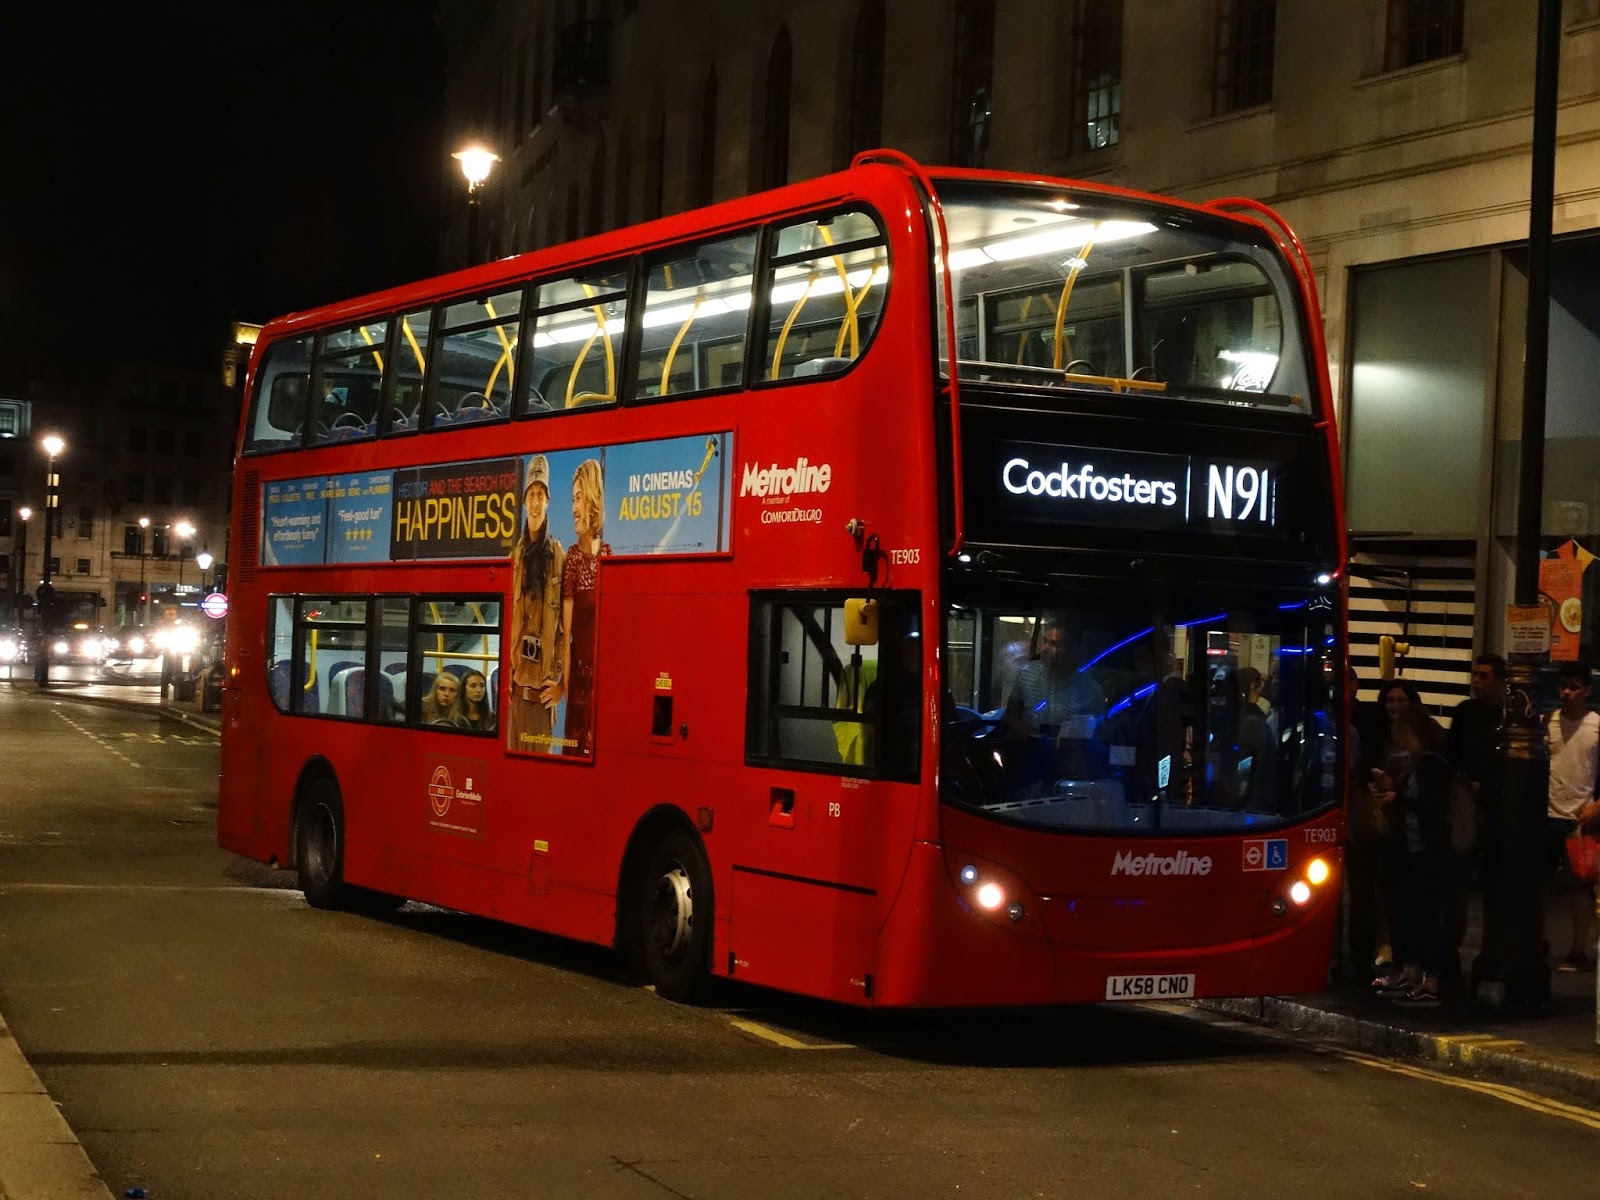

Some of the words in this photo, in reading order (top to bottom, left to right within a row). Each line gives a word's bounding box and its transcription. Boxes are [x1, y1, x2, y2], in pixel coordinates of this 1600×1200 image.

[428, 478, 446, 496] AND
[447, 476, 462, 494] THE
[464, 474, 498, 493] SEARCH
[500, 472, 516, 491] FOR
[629, 474, 641, 493] IN
[642, 469, 693, 492] CINEMAS
[740, 457, 831, 497] Metroline
[1002, 458, 1177, 506] Cockfosters
[1207, 464, 1269, 521] N91
[396, 492, 516, 542] HAPPINESS
[619, 492, 681, 520] AUGUST
[686, 491, 702, 517] 15
[891, 549, 920, 565] TE903
[829, 802, 840, 817] PB
[1304, 828, 1337, 843] TE903
[1111, 850, 1212, 876] Metroline
[1112, 977, 1154, 996] LK58
[1158, 976, 1189, 994] CNO
